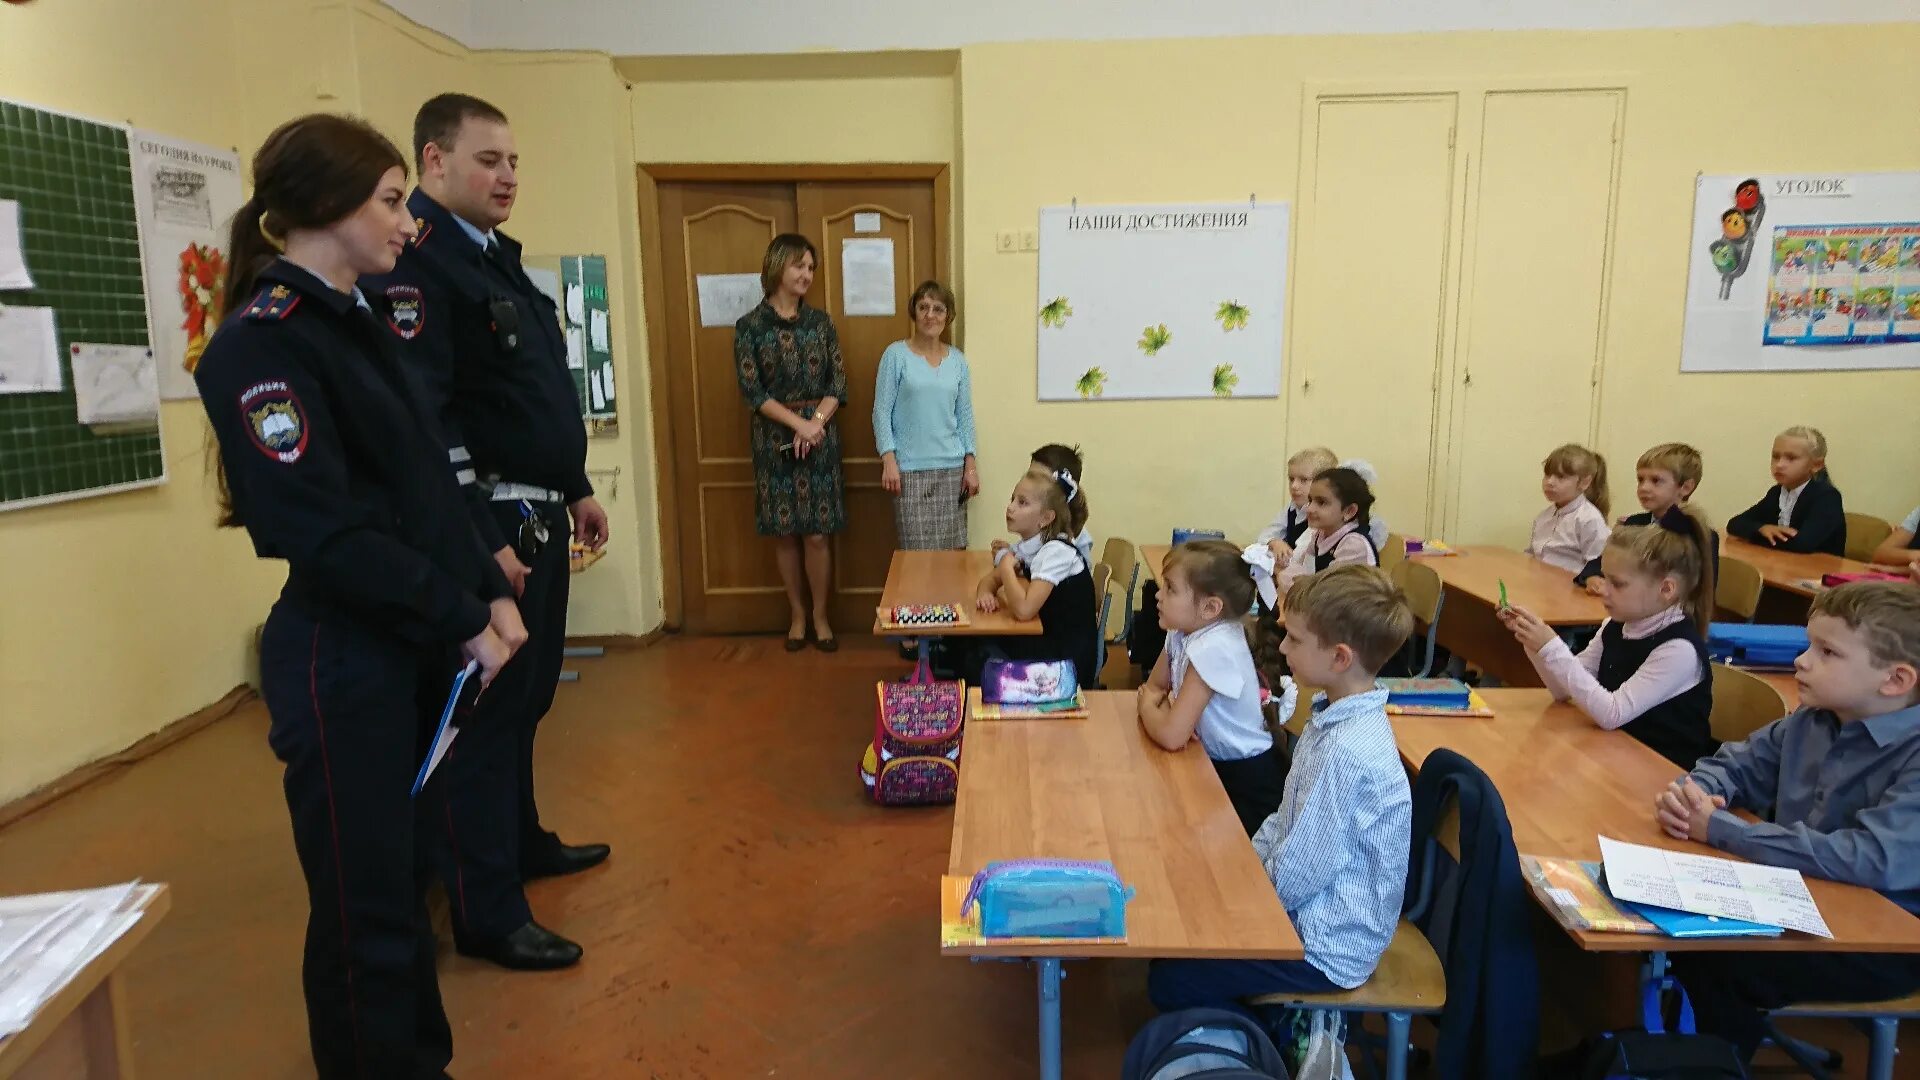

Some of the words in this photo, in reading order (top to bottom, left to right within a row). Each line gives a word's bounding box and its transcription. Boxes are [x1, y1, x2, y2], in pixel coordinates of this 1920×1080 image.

[1776, 179, 1845, 194] УГОЛОК
[1068, 215, 1122, 231] НАШИ
[1124, 212, 1248, 233] ДОСТИЖЕНИЯ
[240, 381, 288, 405] ПОЛИЦИЯ
